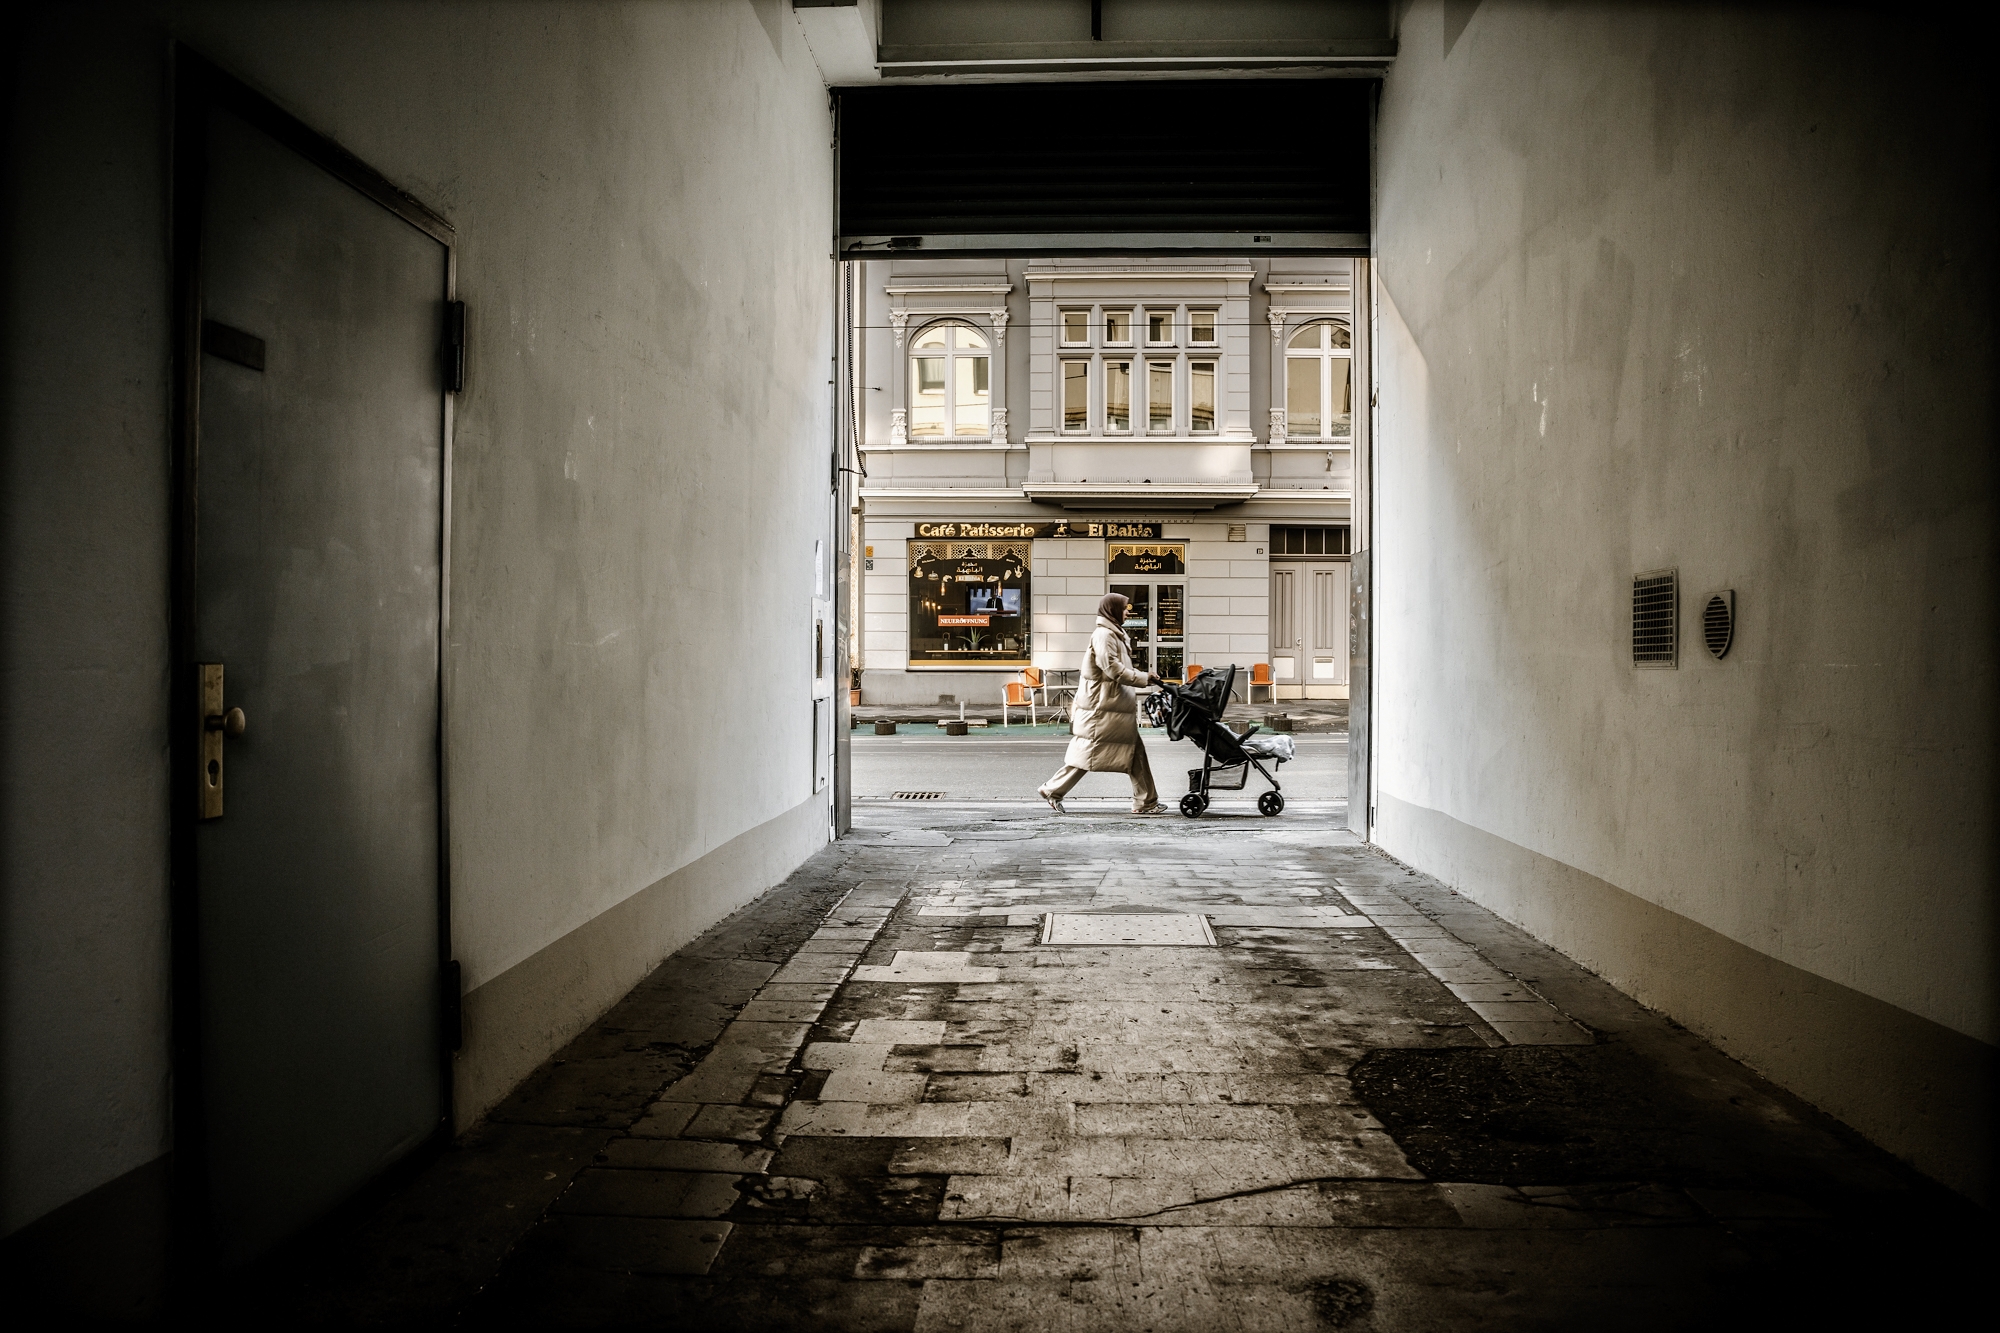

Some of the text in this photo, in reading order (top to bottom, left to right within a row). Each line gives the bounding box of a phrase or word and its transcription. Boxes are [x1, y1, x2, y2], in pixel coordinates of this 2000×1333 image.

[919, 523, 1035, 537] Café Patisserie
[1088, 523, 1153, 537] El Bahia
